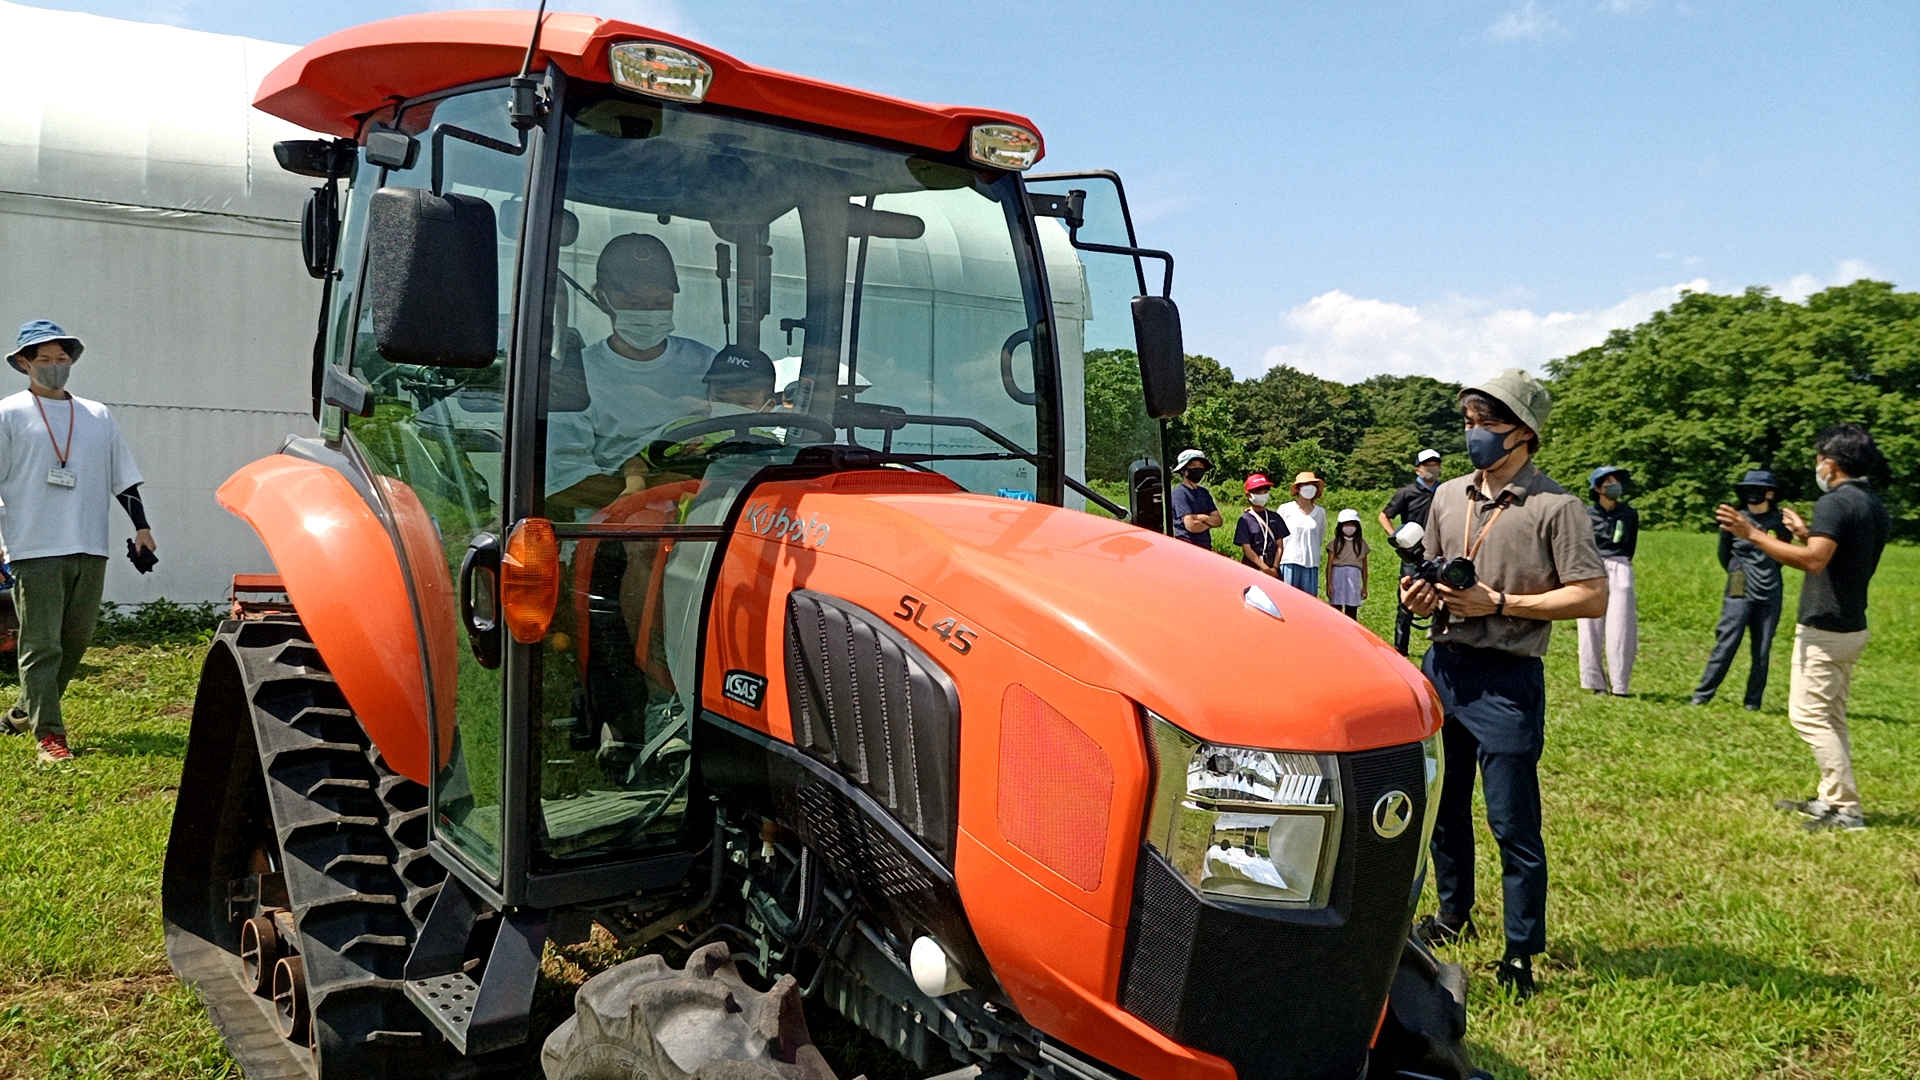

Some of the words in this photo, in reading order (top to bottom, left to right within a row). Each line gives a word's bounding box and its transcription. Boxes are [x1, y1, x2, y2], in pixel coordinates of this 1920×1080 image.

[727, 356, 750, 368] NYC
[744, 501, 830, 547] Kubota
[893, 594, 978, 655] SL45
[725, 674, 758, 701] KSAS
